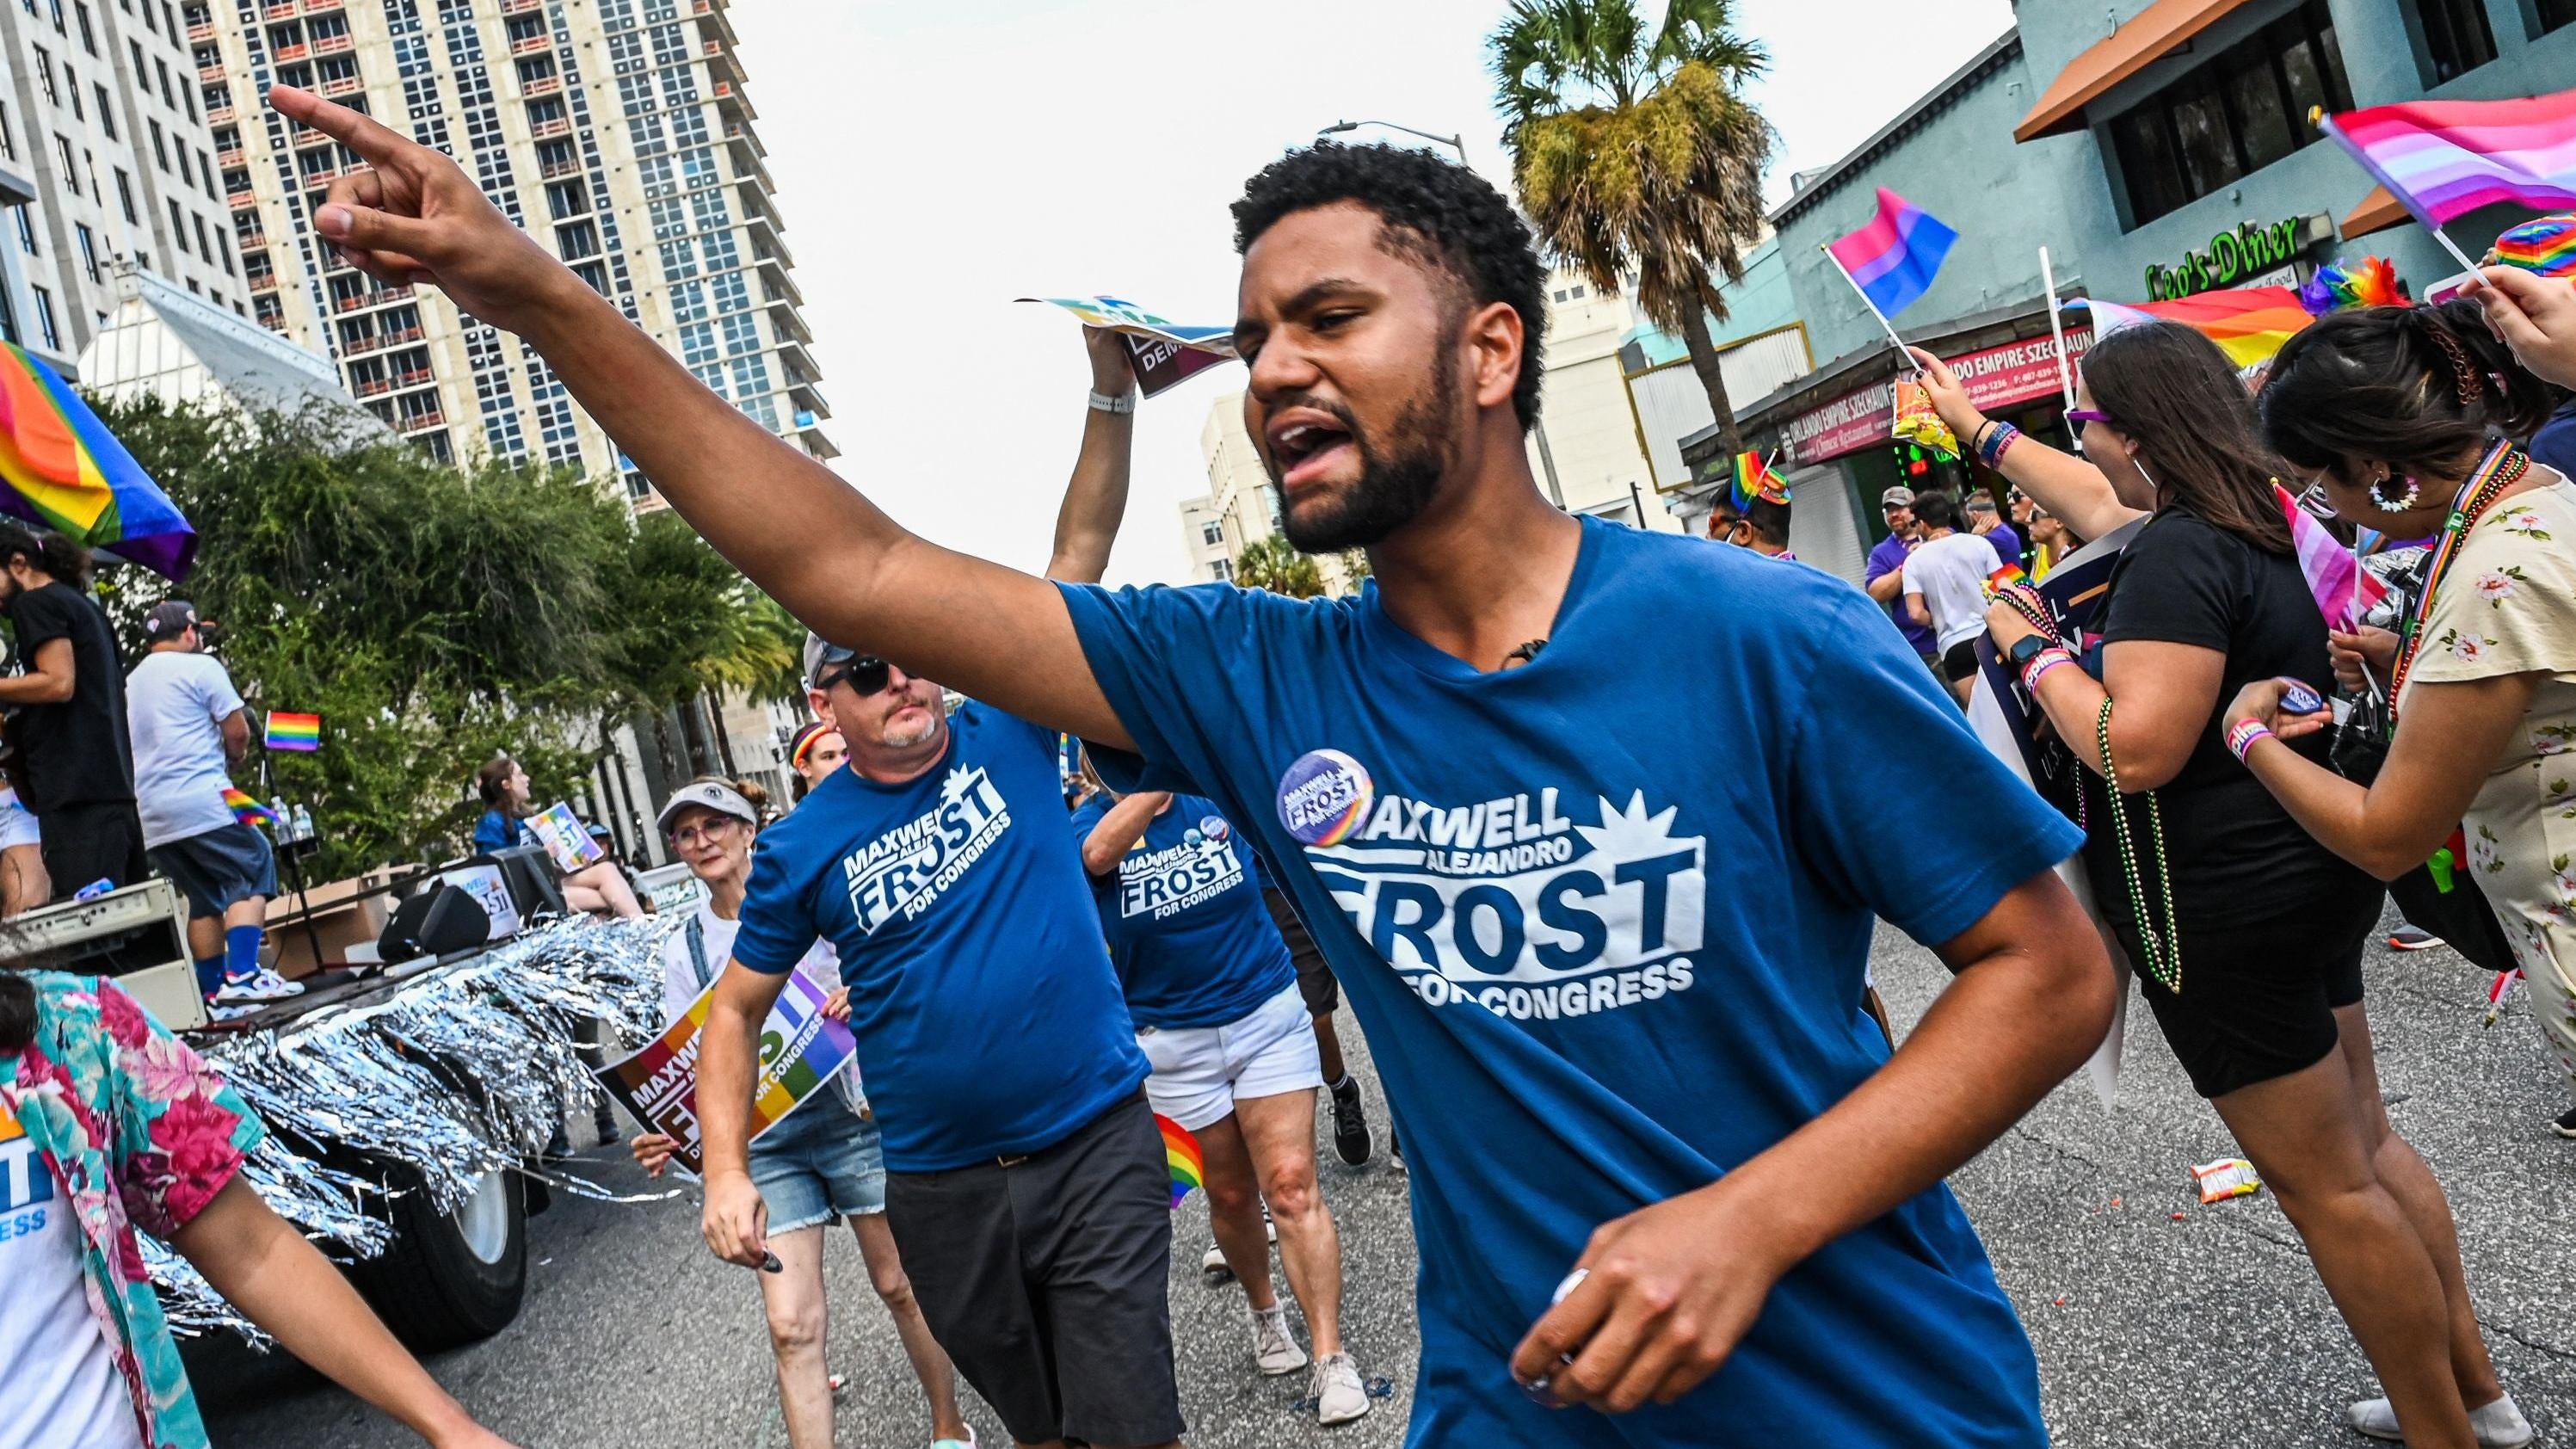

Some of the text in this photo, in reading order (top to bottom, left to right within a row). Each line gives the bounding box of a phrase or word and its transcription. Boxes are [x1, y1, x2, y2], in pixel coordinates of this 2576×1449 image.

[2209, 216, 2300, 285] Diner
[1974, 351, 2026, 376] EMPIRE
[2024, 330, 2093, 363] SZECAUN
[1789, 410, 1824, 444] ORLANDO
[1820, 402, 1852, 431] EMPIRE
[1291, 775, 1357, 827] FROST
[1353, 786, 1571, 849] AXWELL
[843, 804, 944, 880] MAXWE
[854, 771, 993, 931] FROST
[903, 811, 1012, 922] FOR CONGRESS
[1119, 842, 1196, 875] MAXWELL
[1425, 836, 1573, 876] ALEJANDRO
[1123, 845, 1231, 916] FROST
[1154, 871, 1244, 921] FOR CONGRESS
[1477, 957, 1695, 1020] CONGRESS
[768, 1011, 825, 1084] CONGRESS
